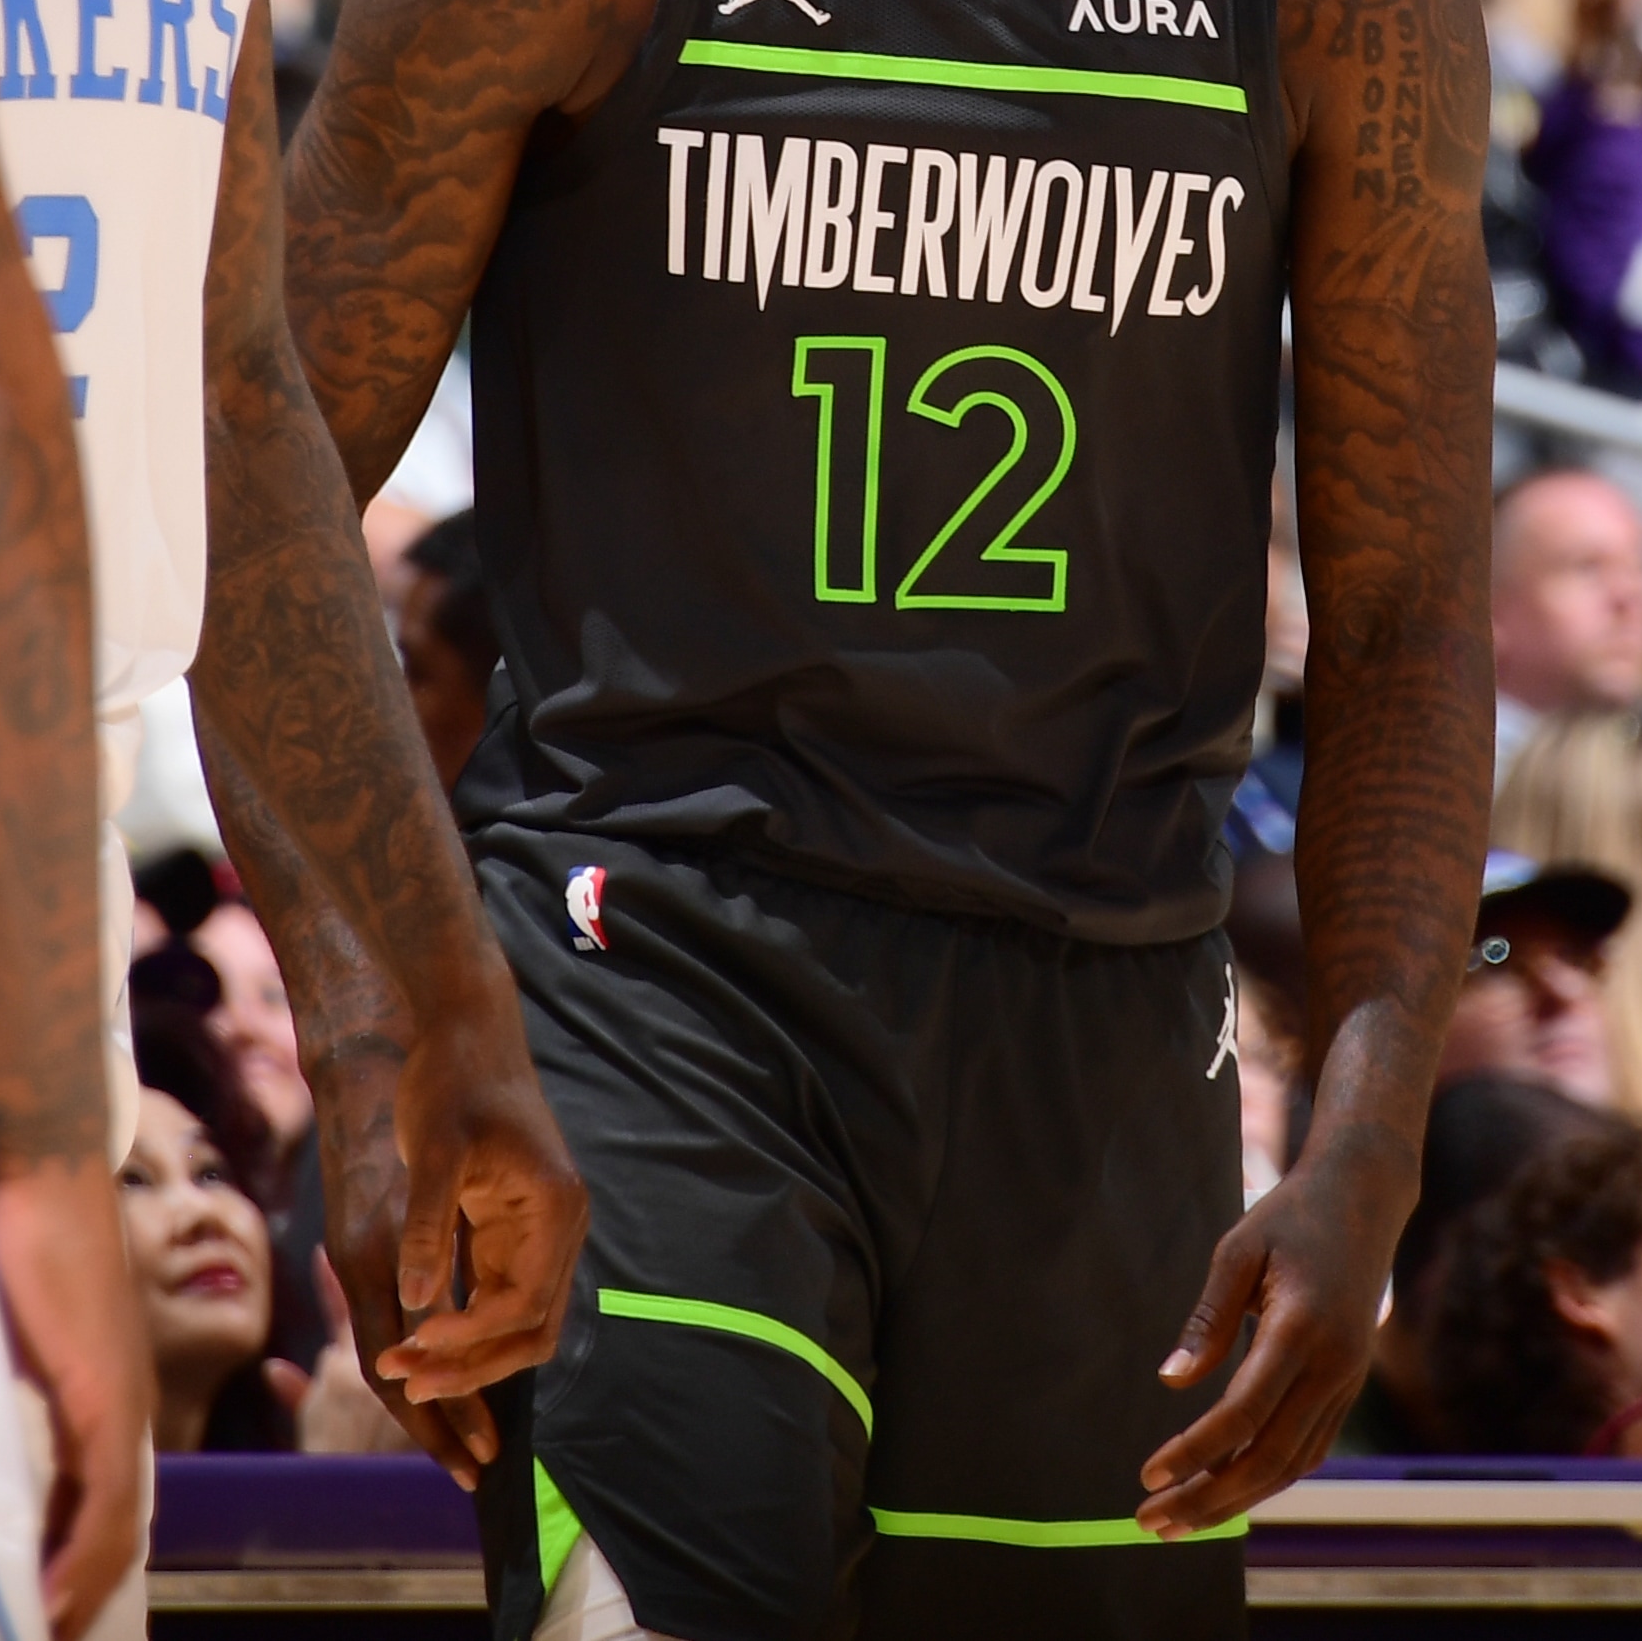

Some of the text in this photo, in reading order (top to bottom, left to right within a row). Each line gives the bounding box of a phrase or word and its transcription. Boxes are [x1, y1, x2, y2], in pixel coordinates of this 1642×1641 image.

[1353, 19, 1387, 202] BORN
[1389, 8, 1423, 210] SINNER
[657, 127, 1245, 337] TIMBERWOLVES
[791, 335, 1077, 612] 12
